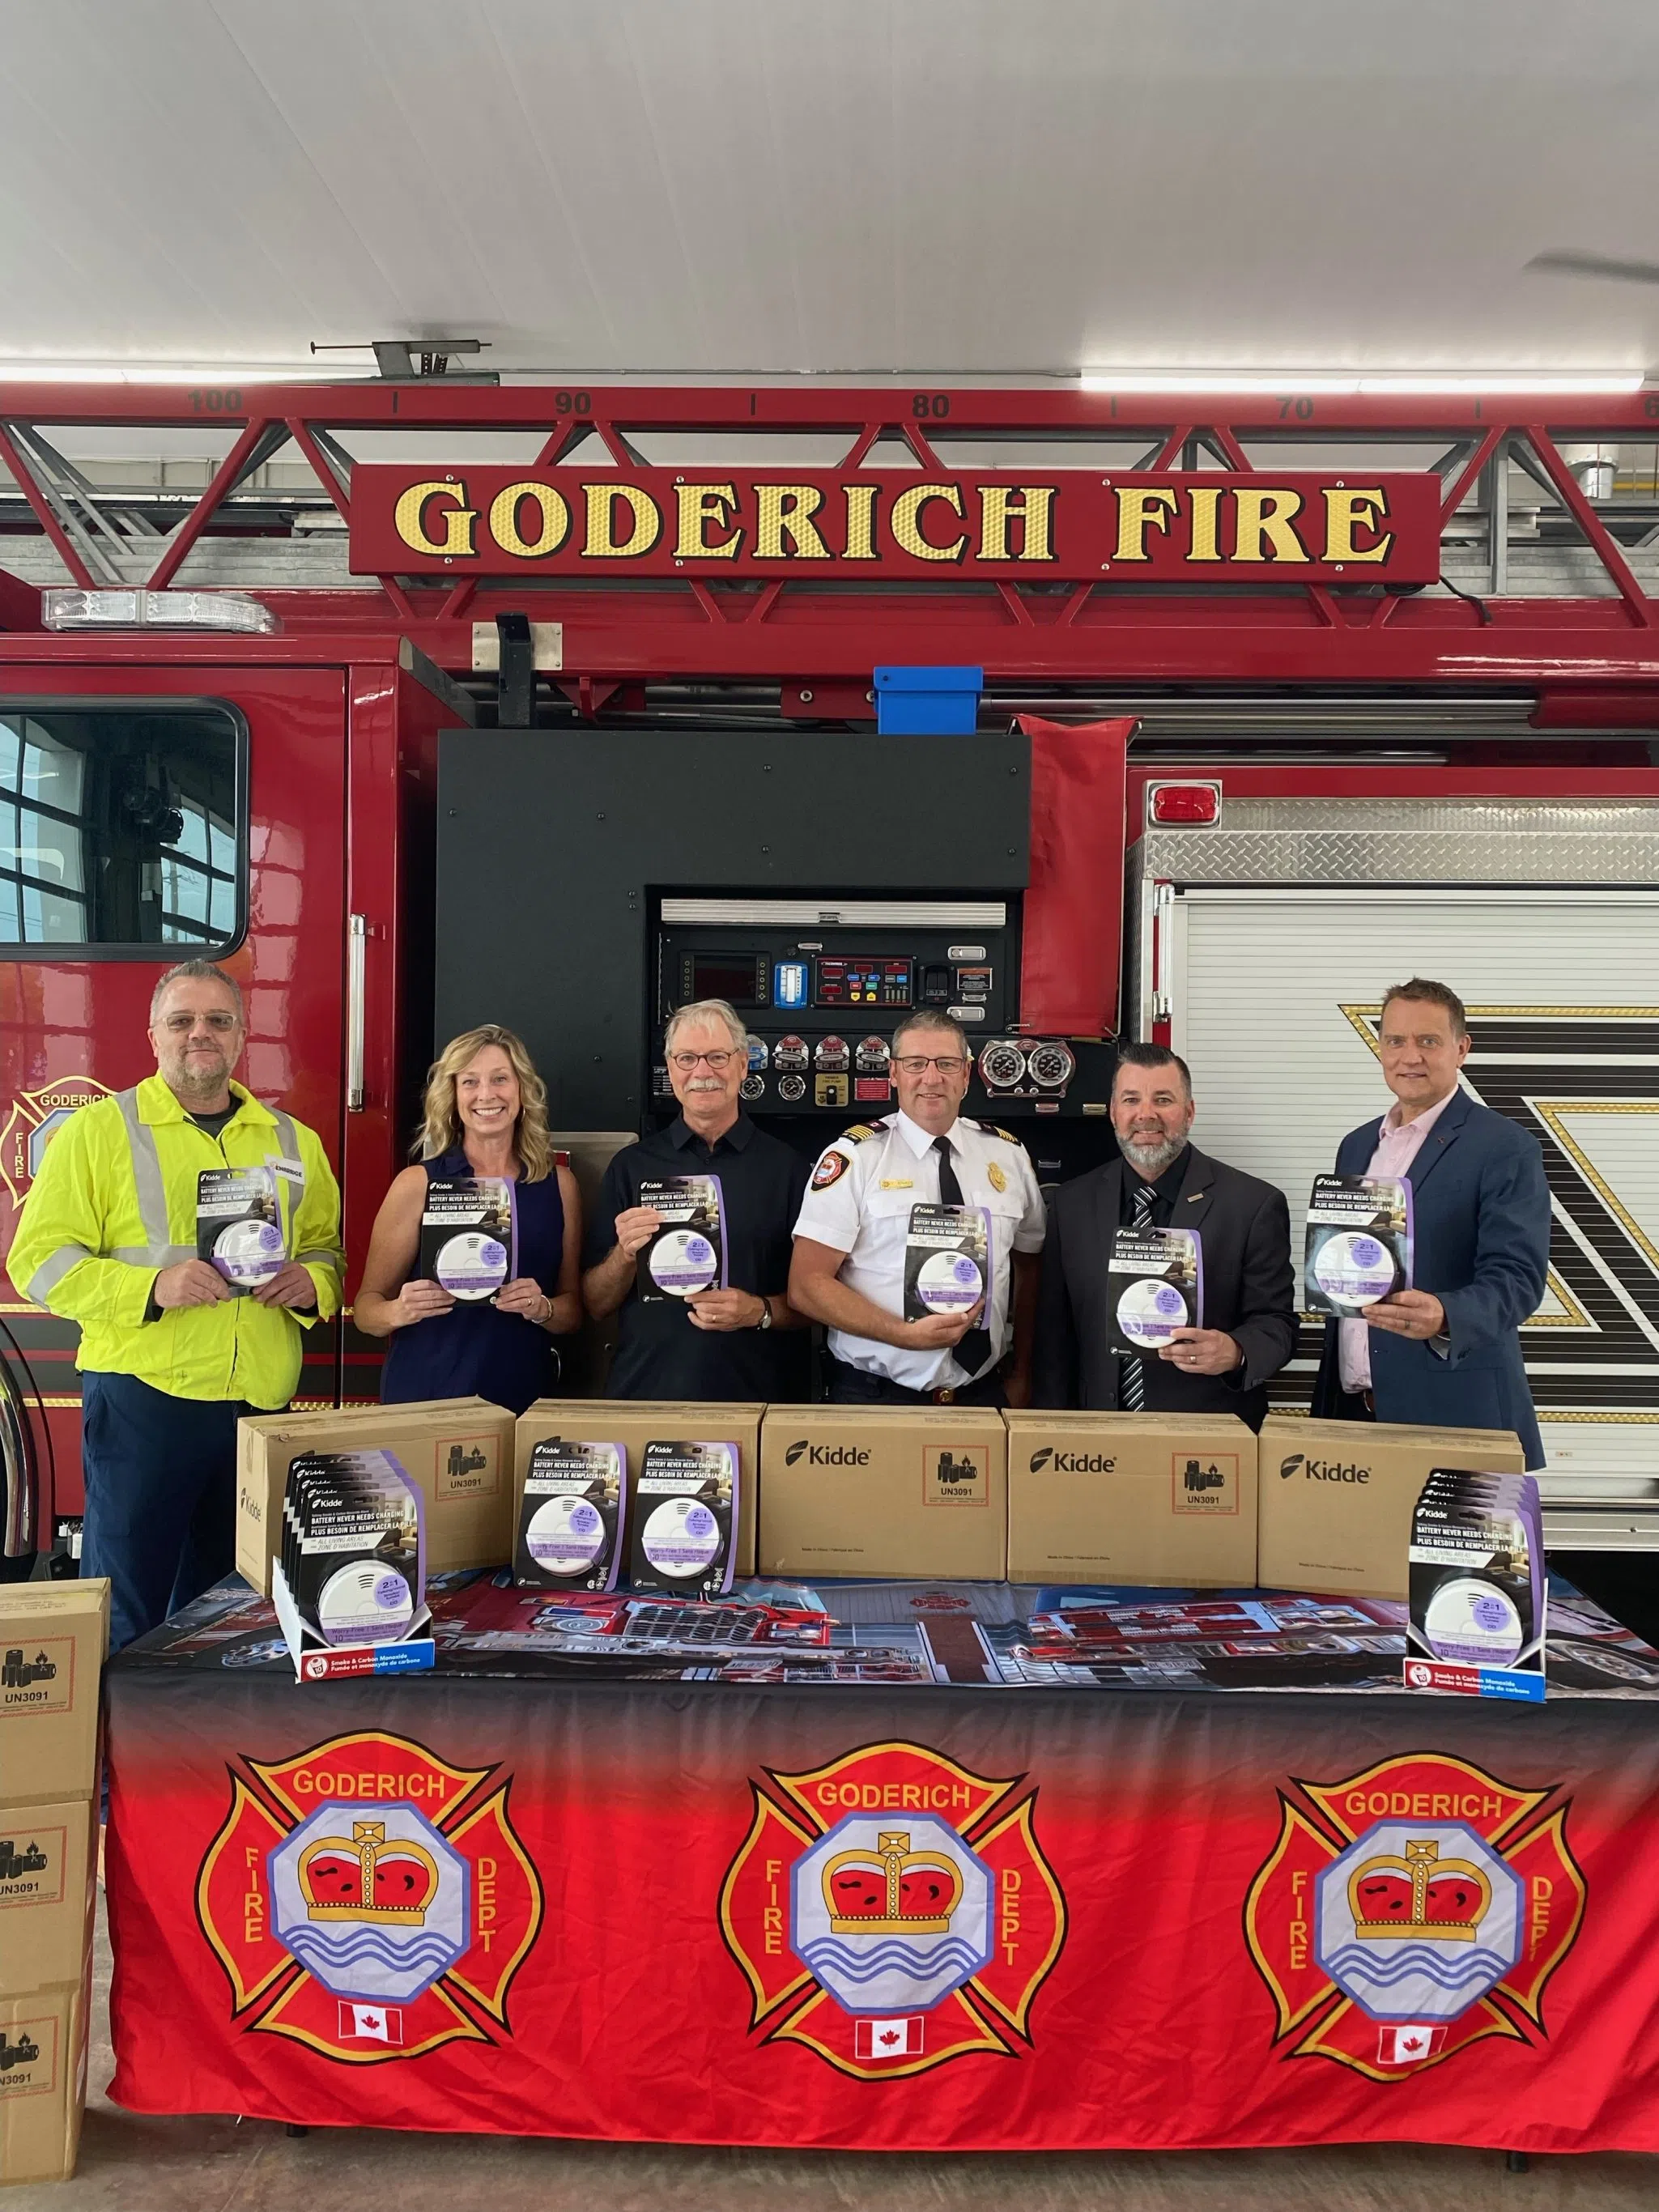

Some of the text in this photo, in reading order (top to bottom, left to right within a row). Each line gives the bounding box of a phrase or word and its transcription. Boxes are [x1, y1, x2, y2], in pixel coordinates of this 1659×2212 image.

[188, 389, 241, 411] 100
[555, 392, 590, 414] 90
[912, 394, 949, 417] 80
[1276, 396, 1314, 419] 70
[393, 478, 1394, 565] GODERICH FIRE
[15, 1133, 24, 1179] FIRE
[275, 1166, 303, 1178] ENBRIDGE
[810, 1446, 871, 1465] Kidde
[1054, 1453, 1117, 1472] Kidde
[1306, 1461, 1371, 1484] Kidde
[450, 1478, 482, 1489] UN3091
[941, 1487, 972, 1496] UN3091
[321, 1499, 342, 1508] Kidde
[1188, 1495, 1220, 1504] UN3091
[312, 1516, 335, 1525] BATTERY
[1426, 1510, 1448, 1519] Kidde
[311, 1528, 325, 1536] PLUS
[327, 1526, 348, 1534] BESOIN
[359, 1523, 391, 1532] REMPLACER
[1417, 1526, 1441, 1534] BATTERY
[1463, 1530, 1482, 1538] NEEDS
[1434, 1539, 1455, 1547] BESOIN
[1465, 1542, 1499, 1551] REMPLACER
[1464, 1682, 1495, 1691] monoxyde
[1486, 1678, 1515, 1687] Monoxide
[5, 1691, 49, 1704] UN3091
[292, 1770, 445, 1798] GODERICH
[817, 1781, 970, 1809] GODERICH
[1345, 1791, 1502, 1819] GODERICH
[244, 1847, 263, 1943] FIRE
[478, 1857, 496, 1953] DEPT
[764, 1859, 782, 1955] FIRE
[1002, 1868, 1021, 1966] DEPT
[1290, 1871, 1308, 1970] FIRE
